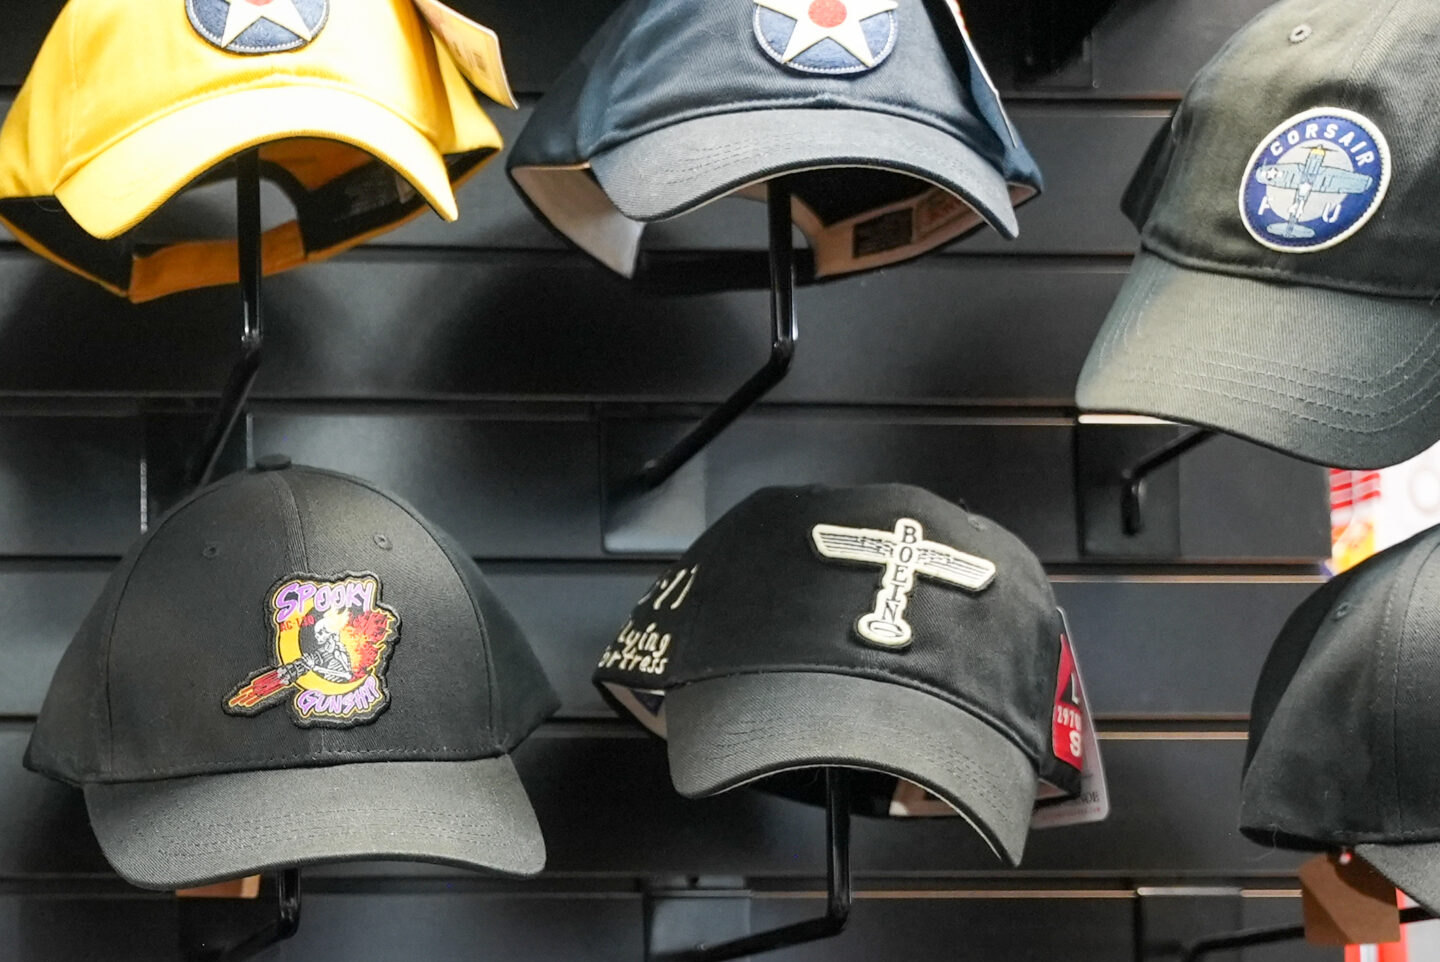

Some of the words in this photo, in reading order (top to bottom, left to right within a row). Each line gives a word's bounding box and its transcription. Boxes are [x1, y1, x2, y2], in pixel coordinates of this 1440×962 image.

[1270, 123, 1375, 167] CORSAIR
[276, 582, 374, 623] SPOOKY
[867, 525, 919, 639] BOEING
[297, 675, 380, 715] GUNSHIP
